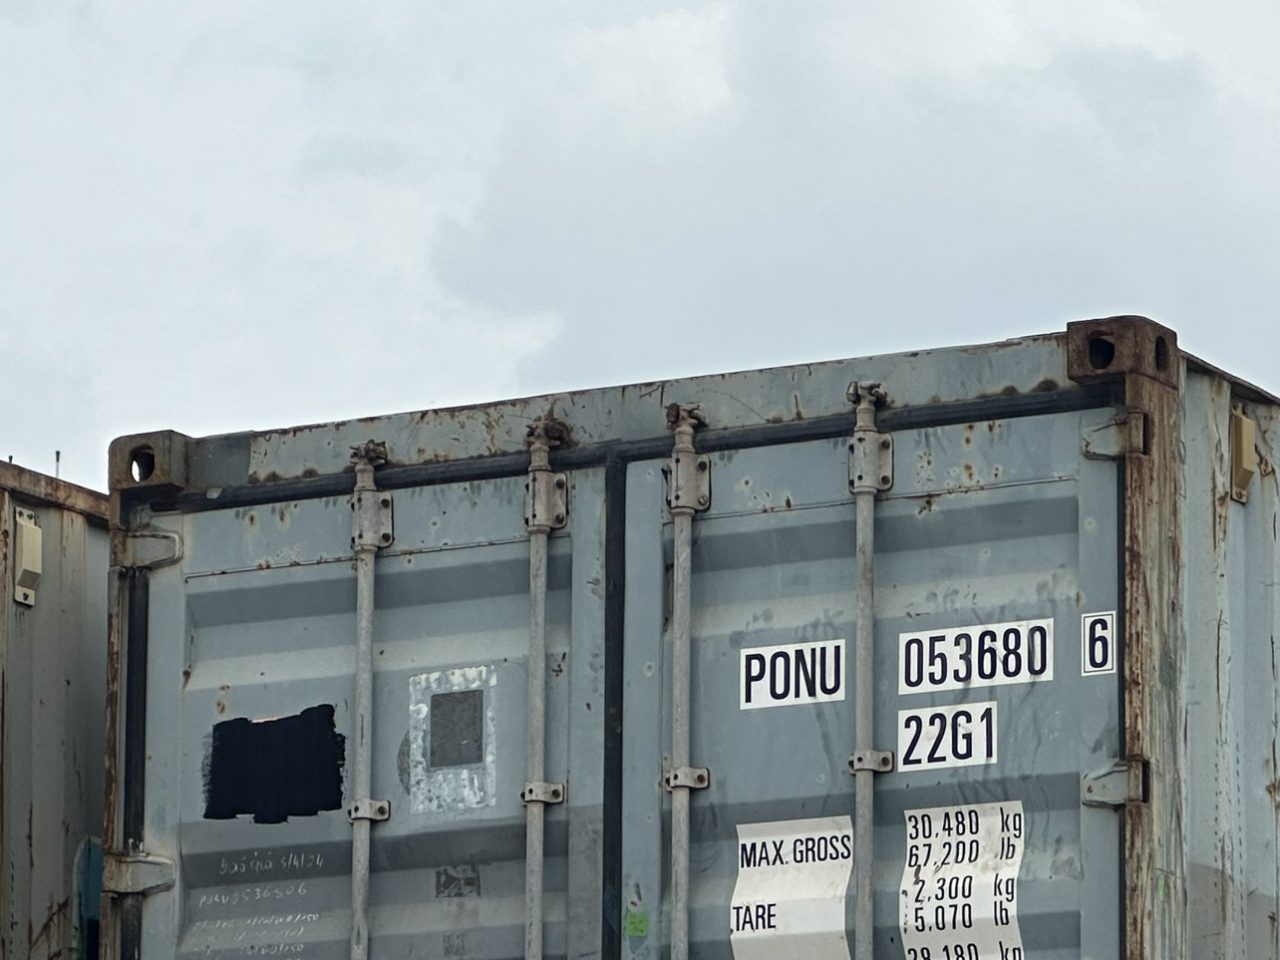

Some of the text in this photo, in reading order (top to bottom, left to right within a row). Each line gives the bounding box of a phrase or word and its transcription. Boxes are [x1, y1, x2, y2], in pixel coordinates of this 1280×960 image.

[744, 618, 1110, 704] PONU 053680 6
[902, 707, 993, 766] 22G1
[1000, 806, 1022, 839] kg
[740, 834, 851, 868] MAX. GROSS
[999, 836, 1016, 861] lb
[993, 873, 1015, 902] kg
[733, 903, 777, 931] TARE
[993, 901, 1010, 926] lb
